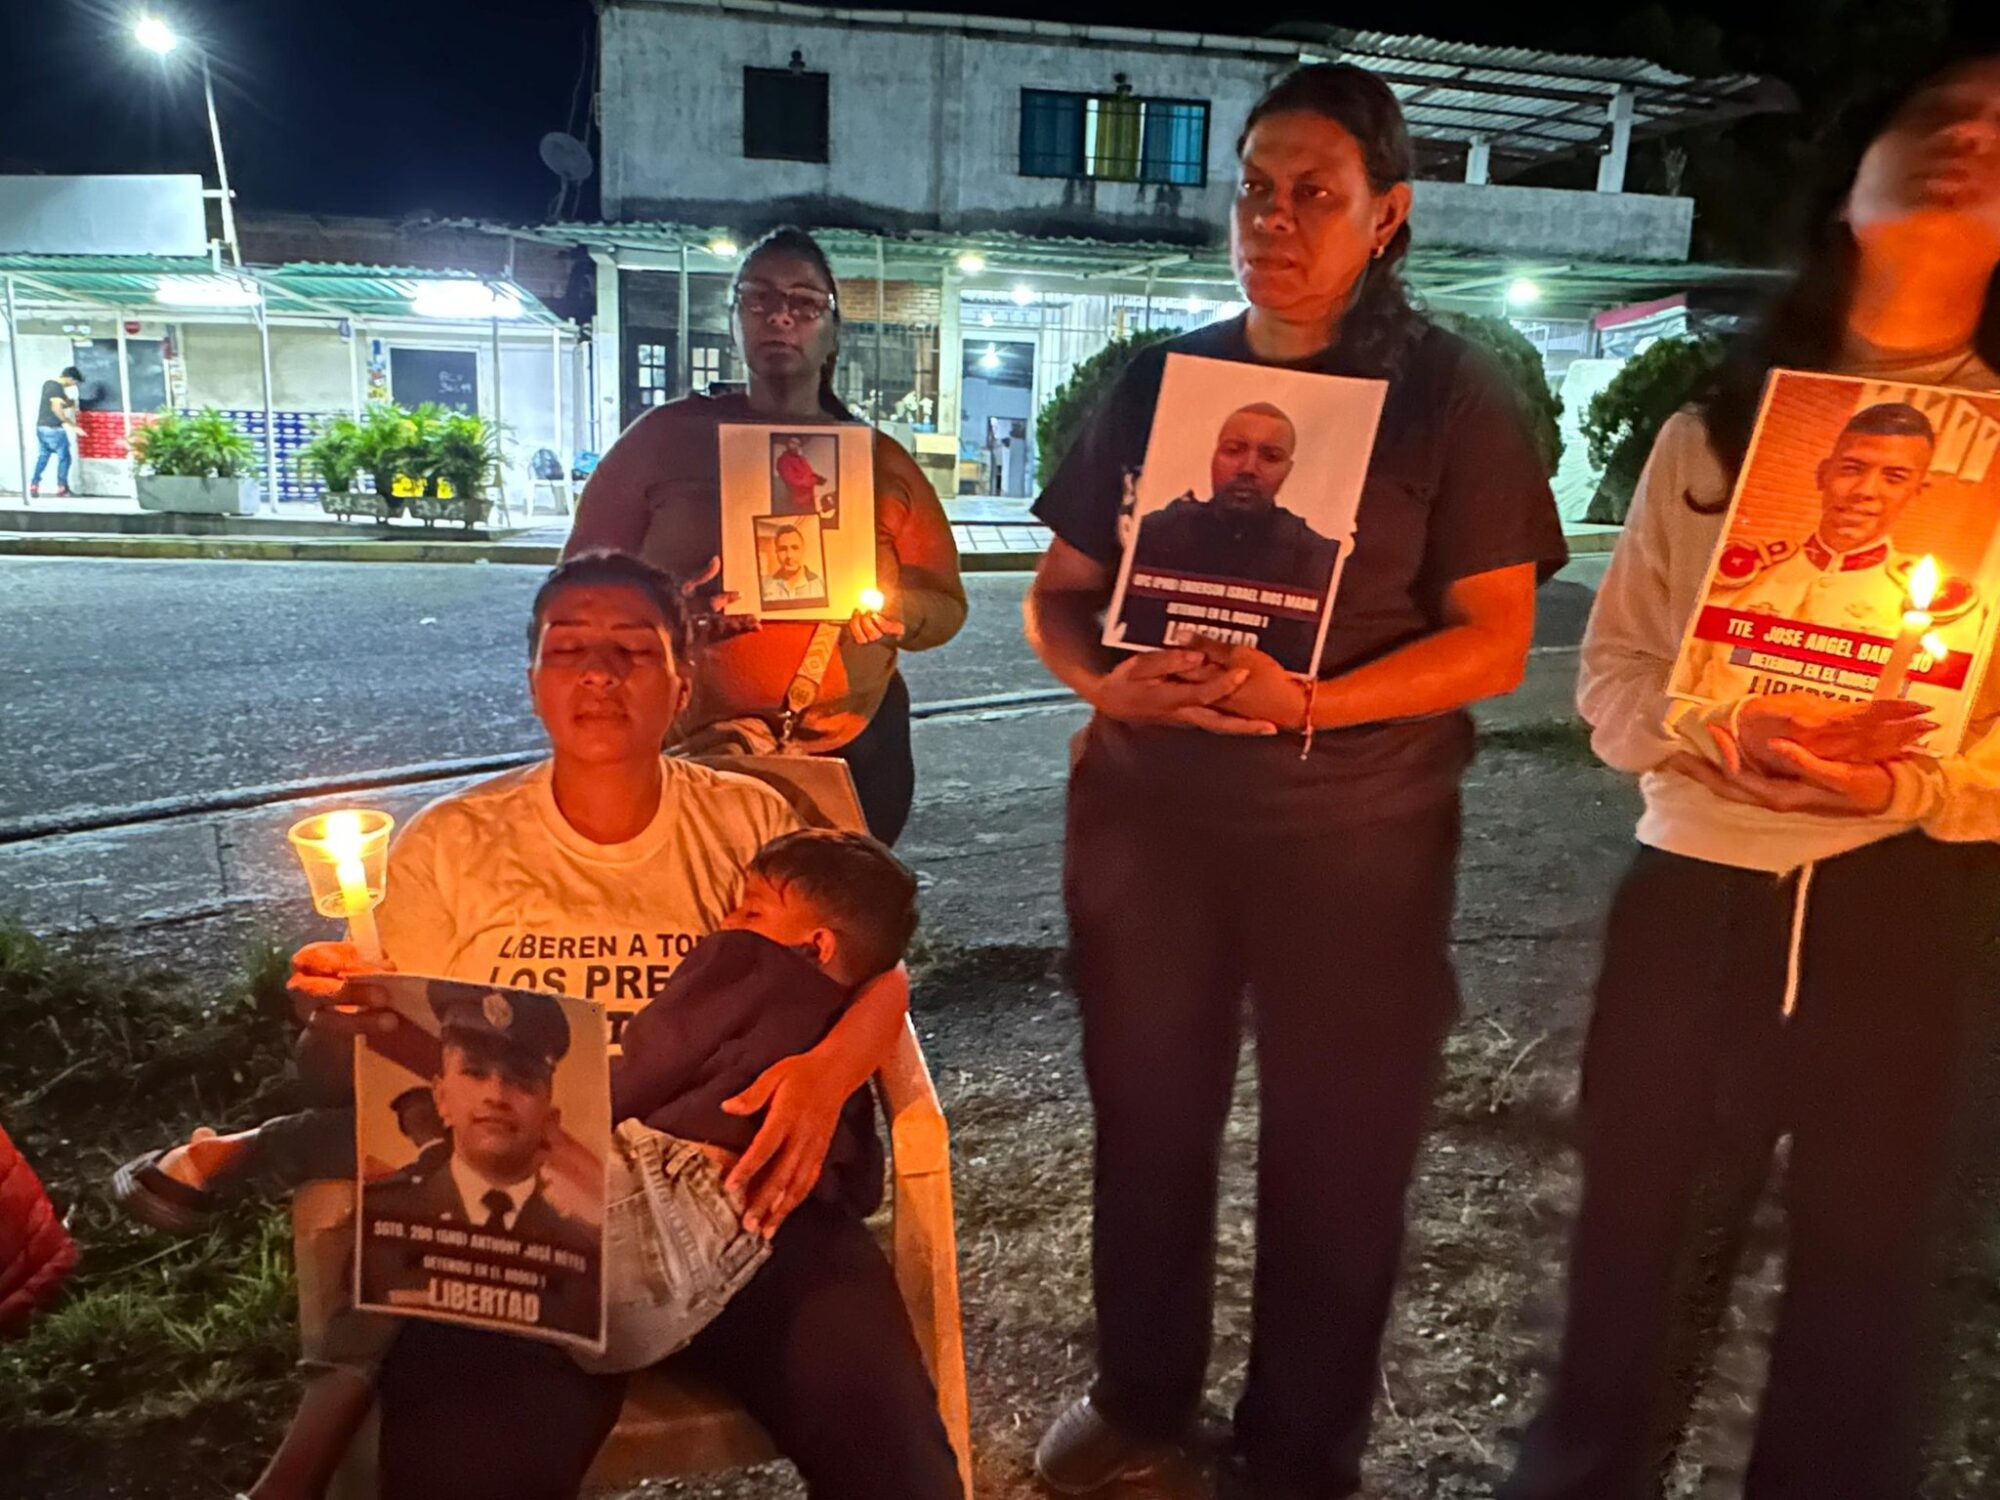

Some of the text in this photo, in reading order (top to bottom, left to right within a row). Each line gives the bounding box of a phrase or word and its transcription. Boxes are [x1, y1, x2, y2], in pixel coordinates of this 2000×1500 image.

[1804, 632, 1854, 658] ANGEL
[1803, 660, 1821, 678] EN
[1821, 663, 1838, 682] EL
[628, 934, 648, 957] A
[586, 965, 671, 999] PRE
[430, 1278, 540, 1323] LIBERTAD
